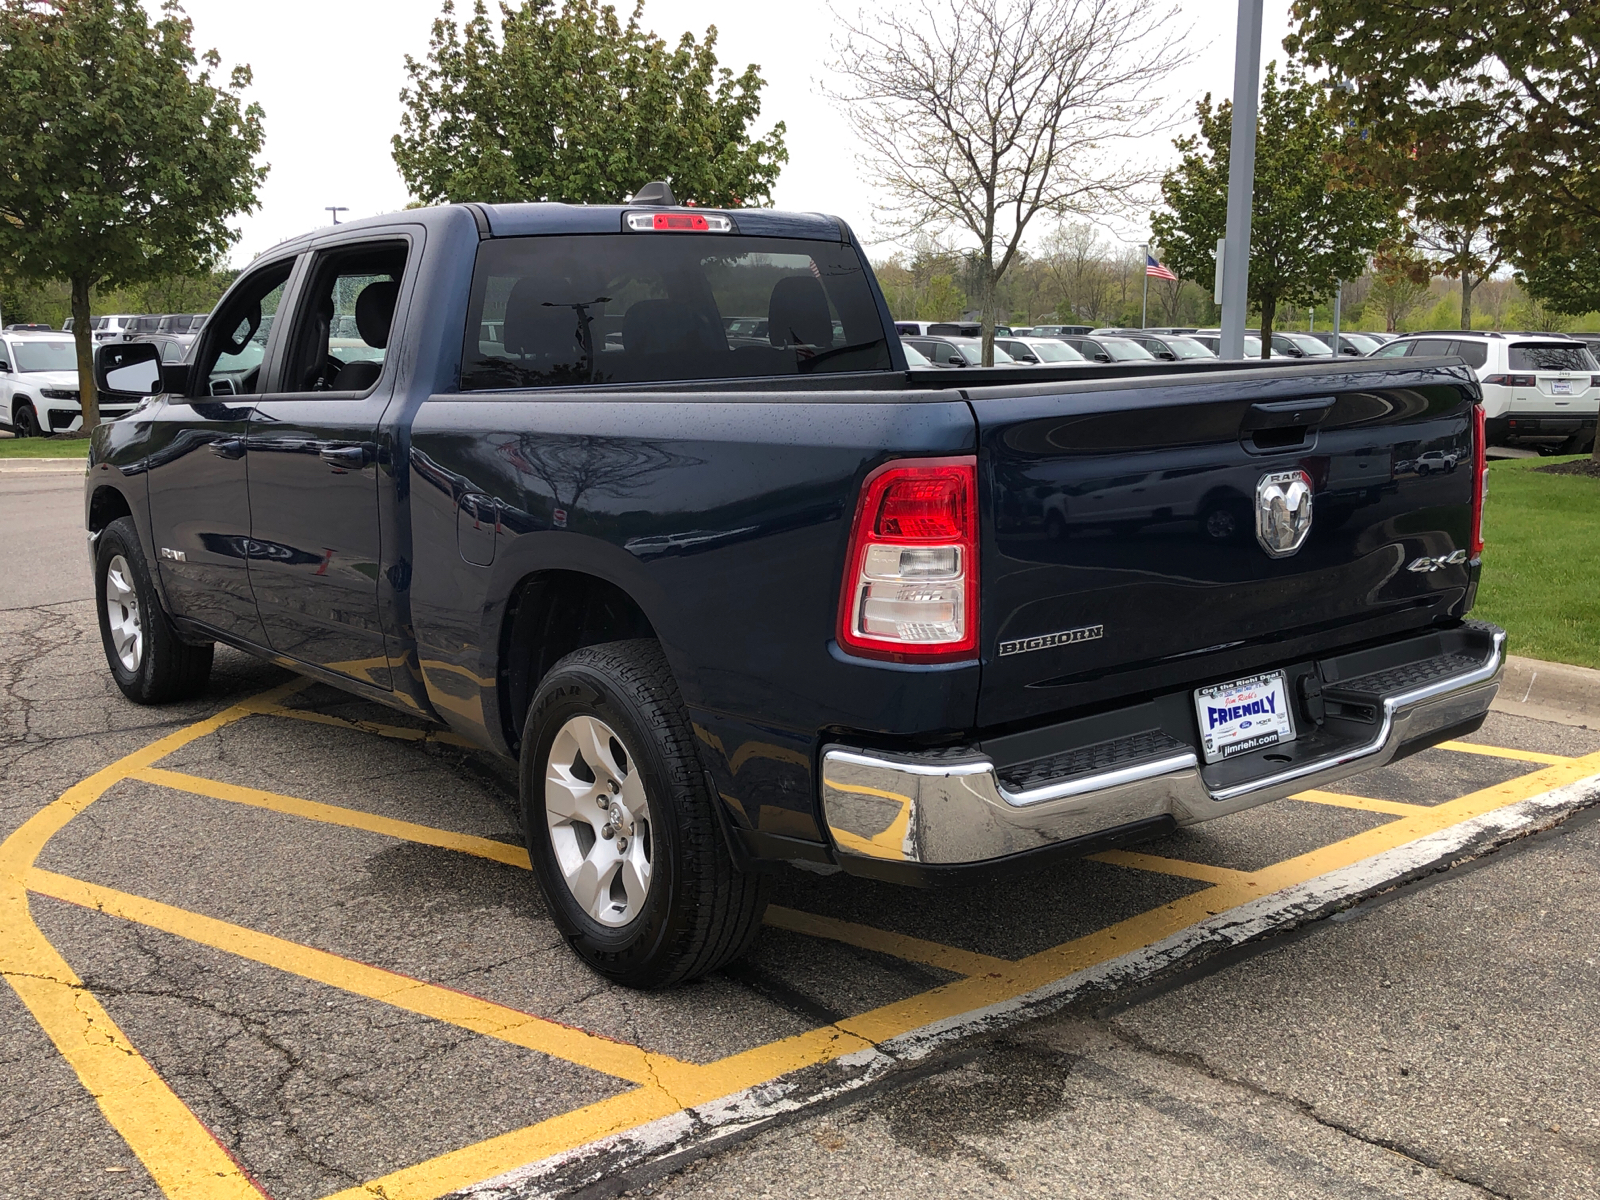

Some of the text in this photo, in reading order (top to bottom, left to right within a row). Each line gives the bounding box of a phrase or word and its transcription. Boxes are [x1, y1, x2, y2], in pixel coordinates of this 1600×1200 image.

[1270, 471, 1302, 482] RAM
[161, 547, 186, 562] RAM
[1406, 549, 1467, 573] 4x4
[998, 624, 1103, 656] BIGHORN
[1202, 686, 1218, 695] Get
[1236, 677, 1258, 686] Riehl
[1260, 672, 1279, 680] Deal
[1207, 690, 1275, 730] FRIENDLY
[1225, 697, 1236, 708] Jim
[1224, 734, 1277, 756] jimriehl.com
